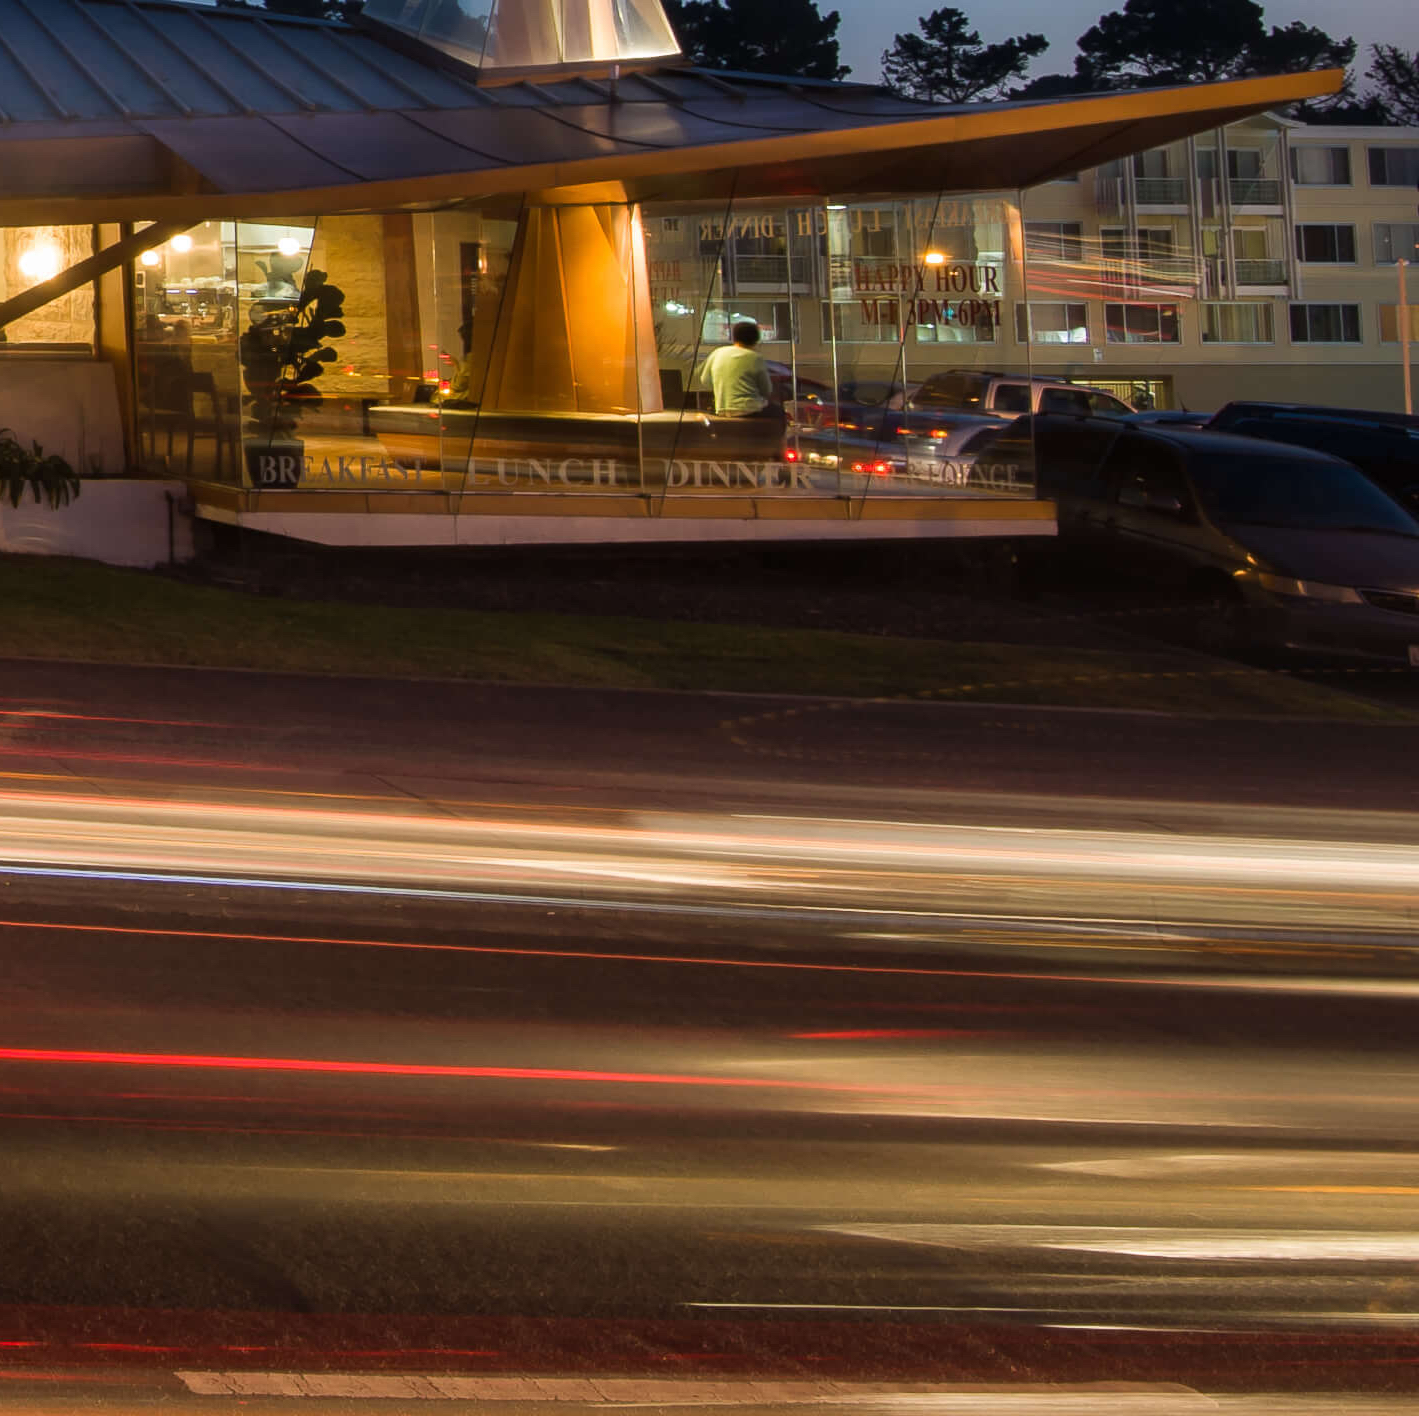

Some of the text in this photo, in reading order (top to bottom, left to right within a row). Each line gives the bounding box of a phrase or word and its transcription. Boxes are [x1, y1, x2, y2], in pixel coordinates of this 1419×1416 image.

[854, 264, 1000, 293] HAPPY HOUR
[258, 455, 428, 484] BREAKFAST
[466, 457, 619, 487] LUNCH
[664, 459, 814, 490] DINNER
